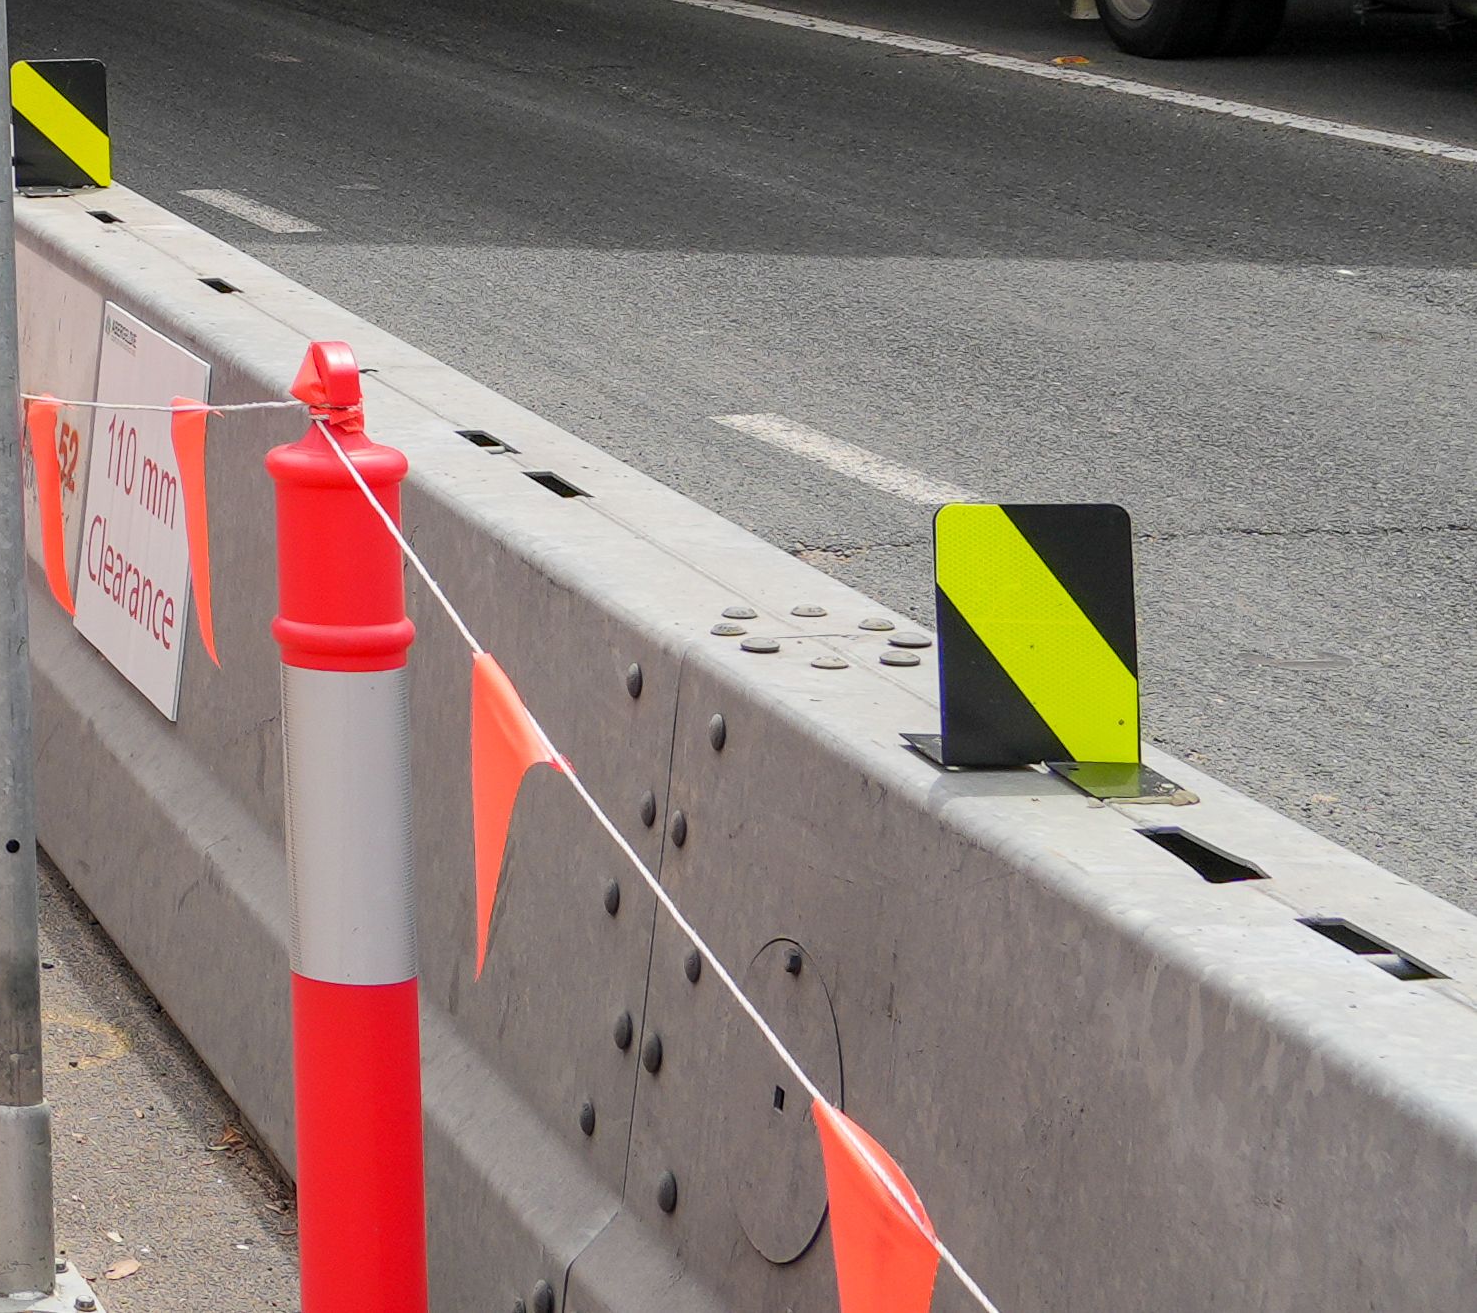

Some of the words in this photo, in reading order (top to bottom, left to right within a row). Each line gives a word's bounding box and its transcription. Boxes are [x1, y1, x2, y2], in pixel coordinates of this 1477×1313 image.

[108, 414, 137, 496] 110
[139, 455, 177, 530] mm
[87, 514, 175, 650] Clearance
